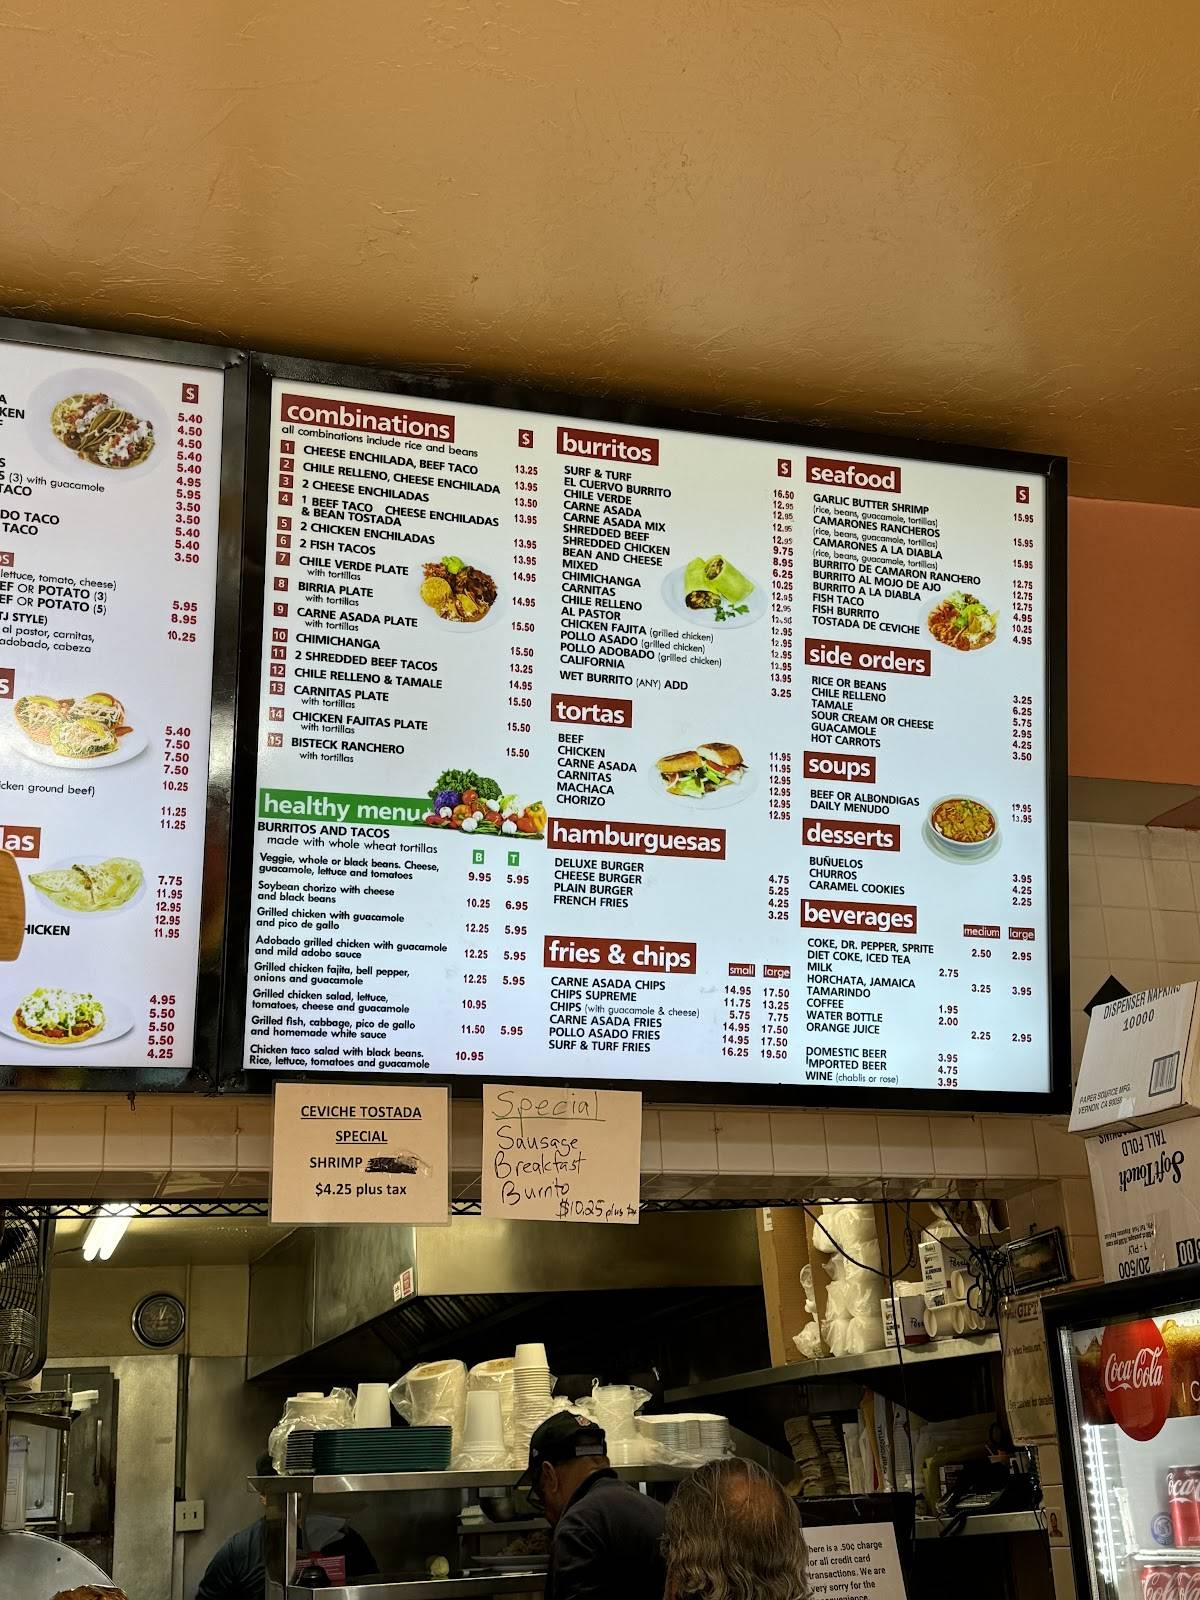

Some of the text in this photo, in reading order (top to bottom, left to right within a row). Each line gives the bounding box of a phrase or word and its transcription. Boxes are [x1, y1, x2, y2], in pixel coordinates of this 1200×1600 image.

[187, 387, 195, 400] $
[178, 413, 202, 424] 5.40
[287, 405, 451, 439] combinations
[178, 426, 202, 437] 4.50
[522, 432, 530, 446] $
[282, 425, 478, 457] all combinations include rice and beans
[562, 432, 652, 462] burritos
[303, 445, 346, 459] CHEESE
[349, 450, 416, 469] ENCHILADA,
[420, 459, 445, 471] BEEF
[448, 462, 478, 475] TACO
[303, 462, 335, 475] CHILE
[338, 466, 390, 482] RELLENO,
[393, 473, 435, 487] CHEESE
[437, 478, 501, 494] ENCHILADA
[515, 464, 538, 476] 13.25
[564, 465, 632, 481] SURF & TURF
[811, 466, 895, 490] seafood
[9, 473, 105, 493] (3) with guacamole
[514, 481, 538, 492] 13.95
[564, 477, 672, 498] EL CUERVO BURRITO
[564, 501, 642, 518] CARNE ASADA
[813, 493, 929, 515] GARLIC BUTTER SHRIMP
[24, 512, 59, 525] TACO
[861, 511, 906, 523] guacamole,
[813, 516, 941, 538] CAMARONES RANCHEROS
[1, 569, 117, 590] lettuce, tomato, cheese)
[18, 584, 34, 593] OR
[38, 585, 90, 599] POTATO
[94, 591, 107, 603] (3)
[173, 601, 198, 612] 5.95
[12, 612, 48, 625] STYLE)
[2, 625, 95, 643] al pastor, carnitas,
[0, 637, 91, 653] adobado, cabeza
[809, 644, 925, 673] side orders
[811, 676, 887, 691] RICE OR BEANS
[556, 701, 625, 724] tortas
[811, 699, 853, 711] TAMALE
[558, 733, 584, 744] BEEF
[558, 746, 605, 758] CHICKEN
[809, 759, 871, 780] soups
[28, 784, 95, 797] ground beef)
[810, 790, 920, 806] BEEF OR ALBONDIGAS
[264, 793, 420, 822] healthy menu
[557, 794, 605, 806] CHORIZO
[258, 822, 390, 839] BURRITOS AND TACOS
[553, 821, 721, 853] hamburguesas
[807, 823, 893, 847] desserts
[267, 836, 438, 854] made with whole wheat tortillas
[555, 858, 644, 872] DELUXE BURGER
[810, 856, 863, 869] BUÑUELOS
[810, 869, 857, 880] CHURROS
[805, 902, 913, 931] beverages
[24, 924, 70, 936] HICKEN
[964, 926, 1035, 940] medium large
[807, 939, 934, 954] COKE, DR. PEPPER, SPRITE
[972, 948, 1032, 961] 2.50 2.95
[549, 940, 691, 972] fries & chips
[730, 965, 790, 979] small large
[724, 985, 790, 998] 14.95 17.50
[1103, 992, 1146, 1020] DISPENSER
[1123, 1009, 1155, 1031] 10000
[301, 1105, 422, 1118] CEVICHE TOSTADA
[492, 1090, 599, 1137] Special
[335, 1131, 388, 1142] SPECIAL
[496, 1125, 579, 1157] Sausage
[1144, 1129, 1166, 1149] TALL
[1122, 1137, 1144, 1157] FOLD
[309, 1157, 363, 1168] SHRIMP
[494, 1150, 587, 1179] Breakfast
[315, 1182, 407, 1197] $4.25 plus tax
[1118, 1257, 1150, 1279] 20/500
[1105, 1347, 1164, 1391] Coca-Cola
[857, 1541, 883, 1550] charge
[820, 1557, 829, 1565] all
[830, 1555, 852, 1565] credit
[854, 1554, 871, 1563] card
[860, 1567, 872, 1575] We
[874, 1567, 886, 1575] are
[811, 1580, 876, 1594] very sorry for the
